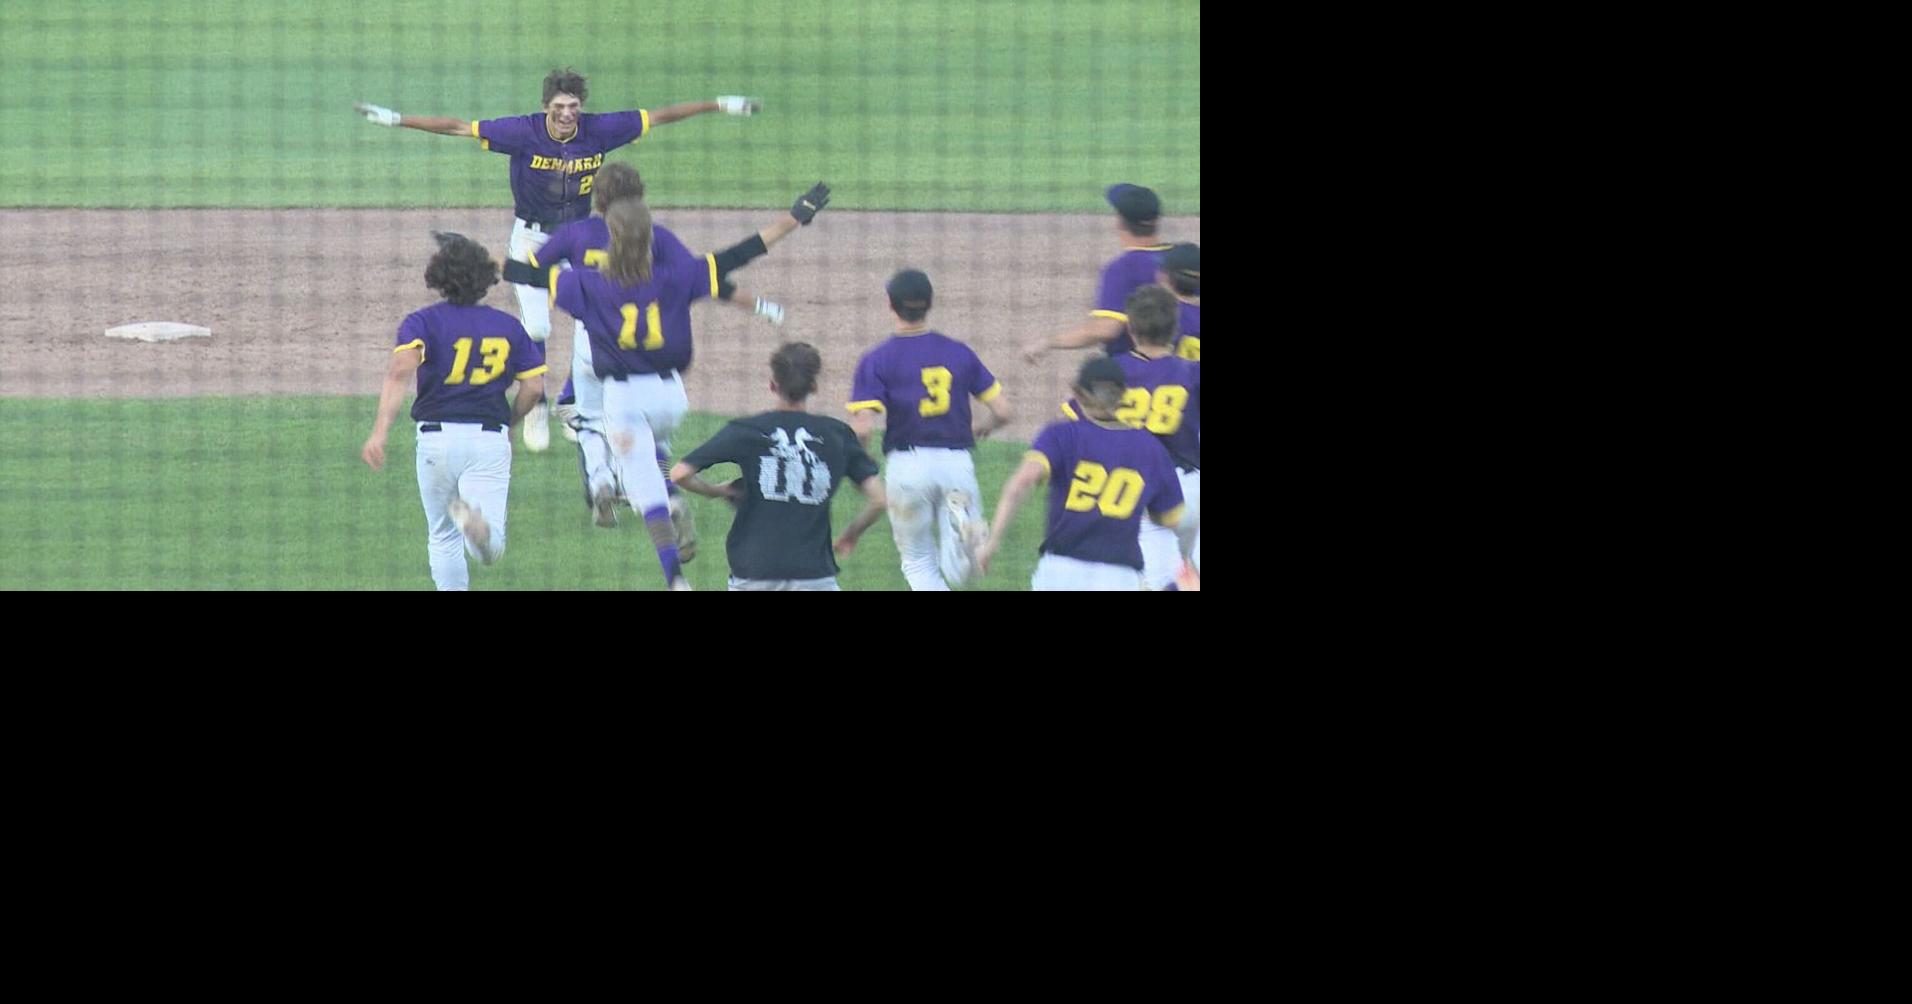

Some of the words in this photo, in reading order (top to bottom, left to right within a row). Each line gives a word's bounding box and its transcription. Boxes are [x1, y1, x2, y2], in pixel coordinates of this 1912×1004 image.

[618, 303, 663, 349] 11
[444, 337, 510, 385] 13
[919, 366, 952, 417] 3
[1115, 385, 1188, 434] 28
[1066, 460, 1145, 519] 20
